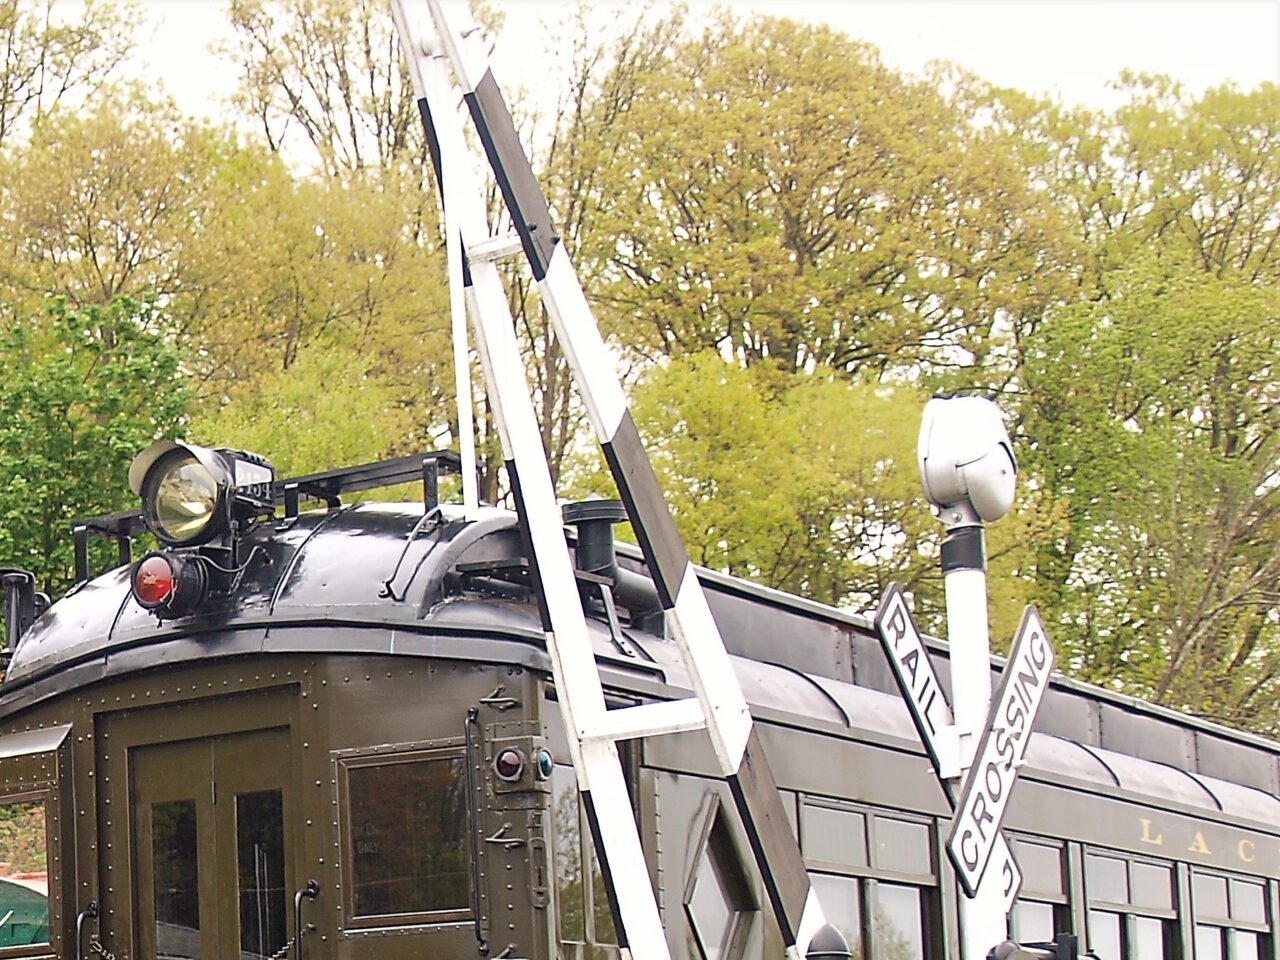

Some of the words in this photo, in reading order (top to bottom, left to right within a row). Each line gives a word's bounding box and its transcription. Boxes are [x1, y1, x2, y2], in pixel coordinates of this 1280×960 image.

[886, 604, 938, 736] RAIL
[961, 631, 1046, 872] CROSSING
[1139, 817, 1280, 868] LAC
